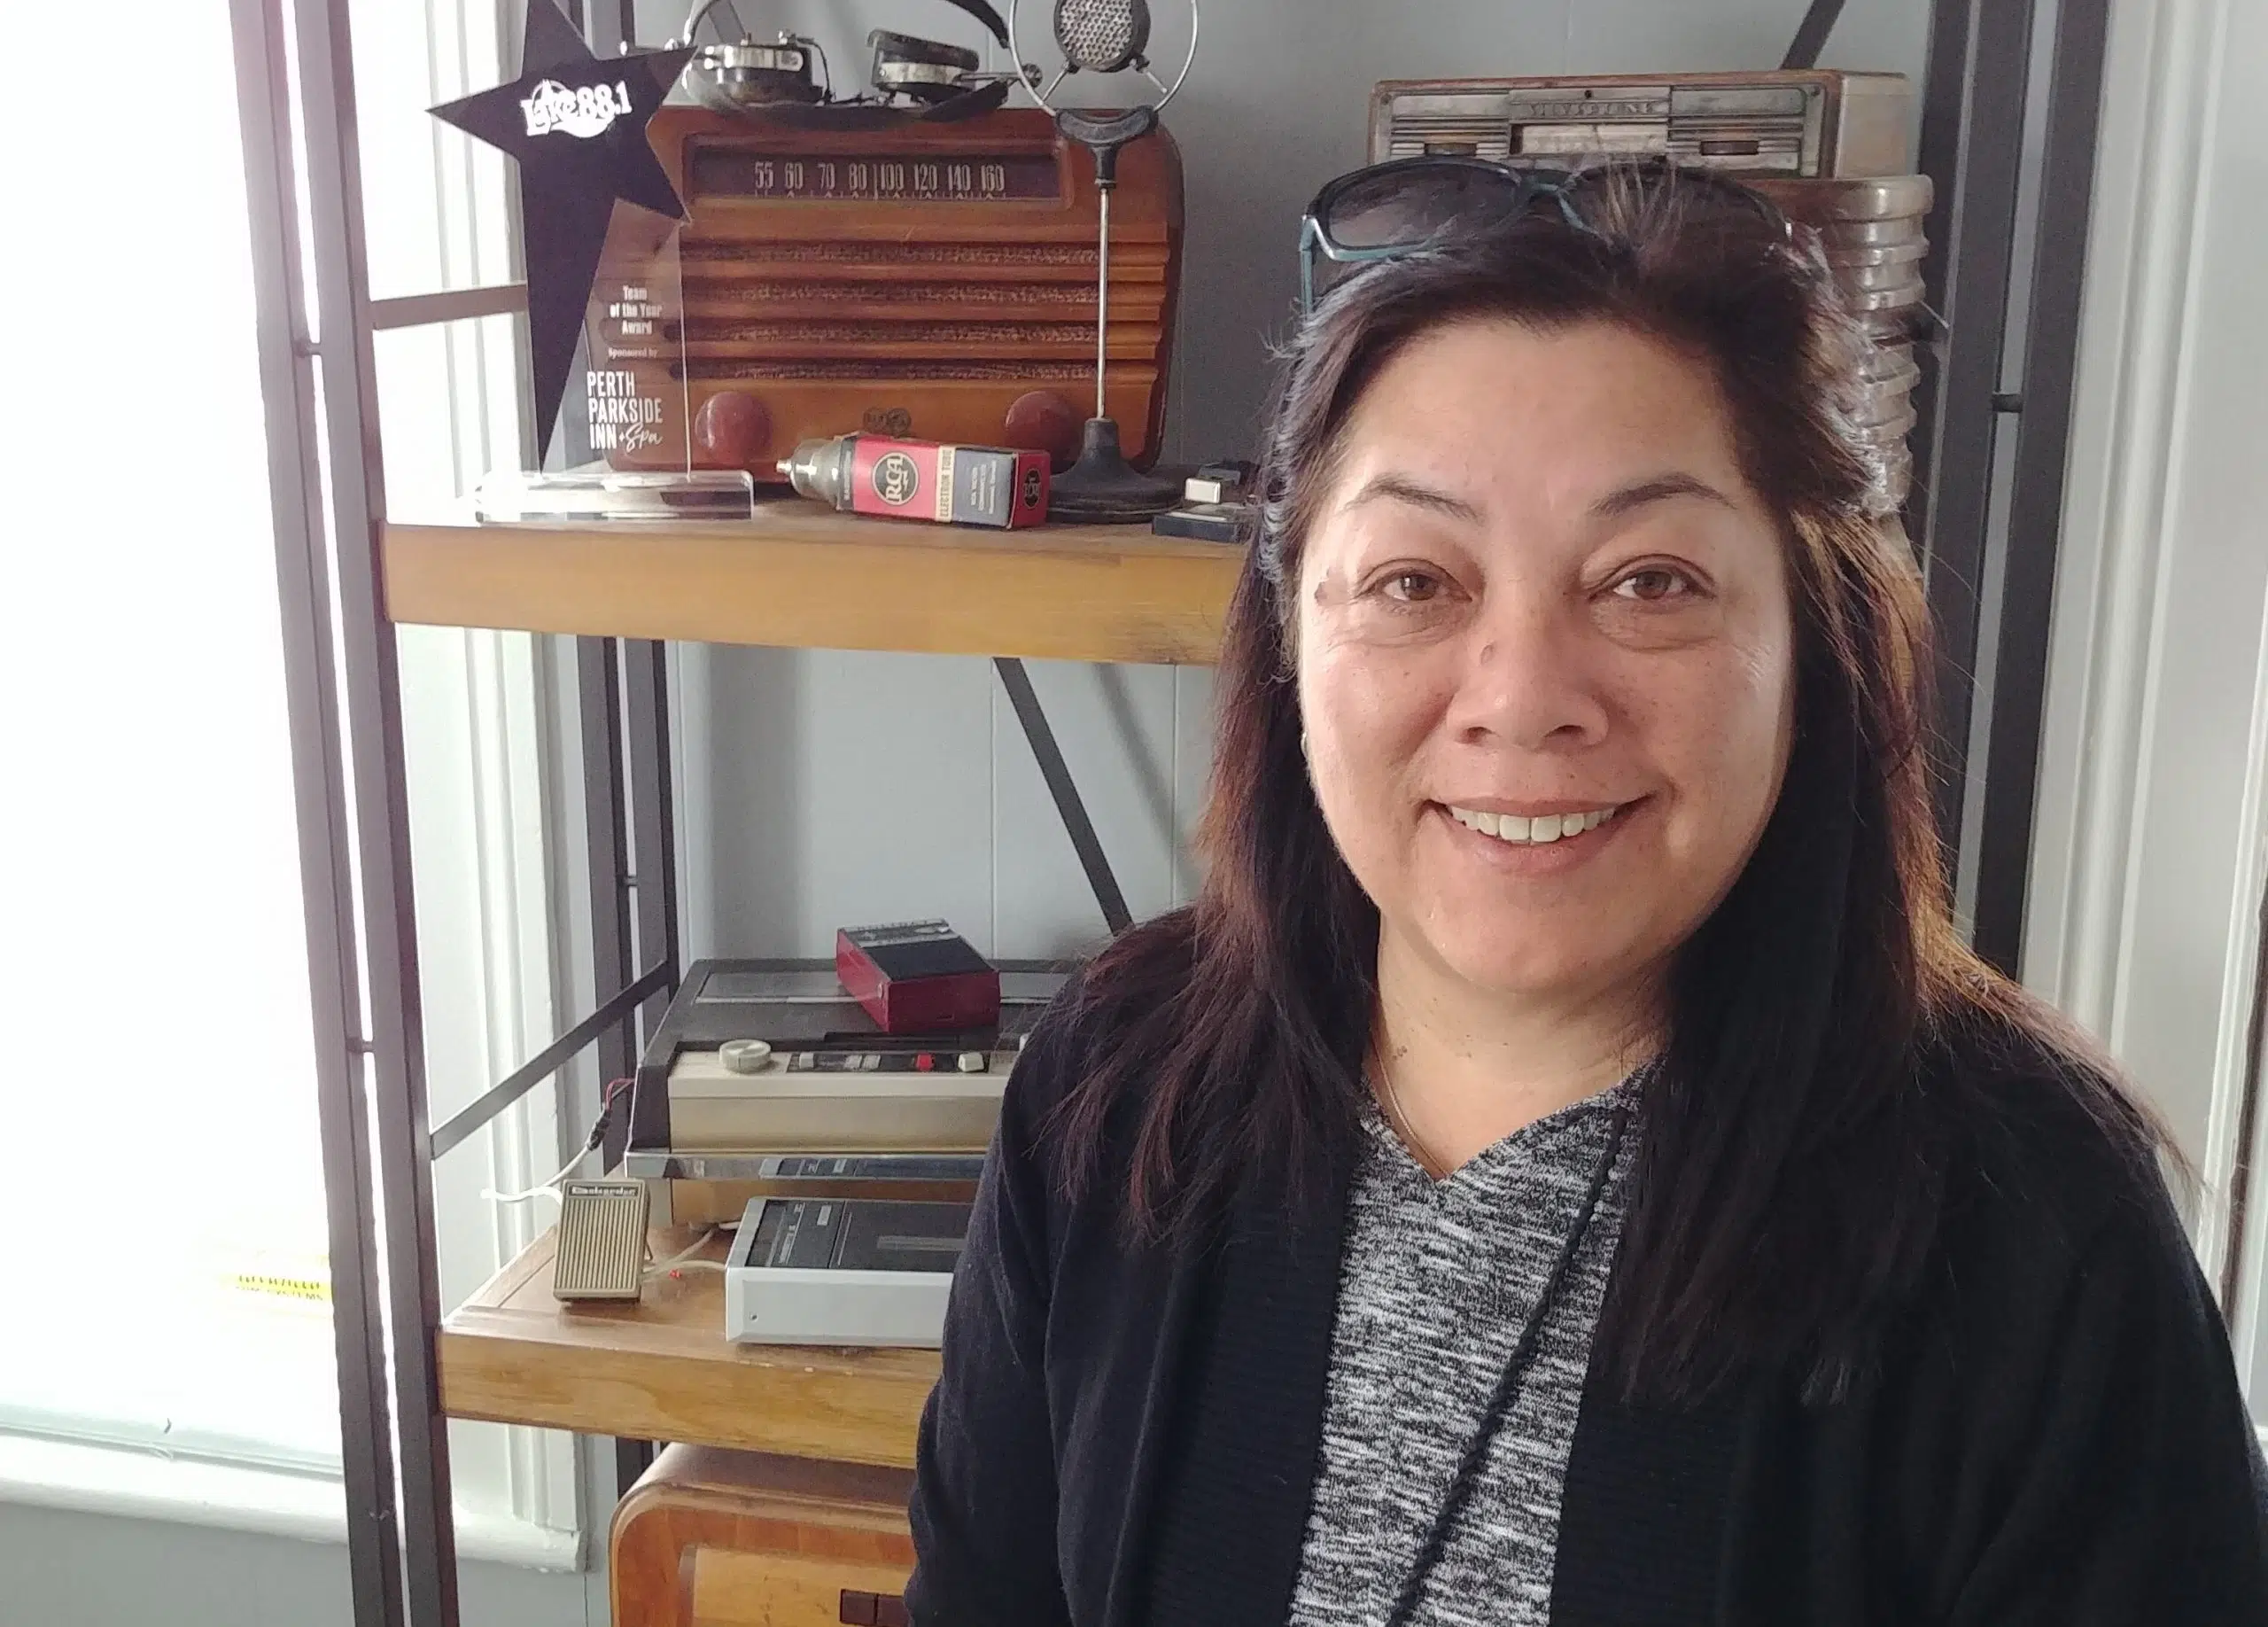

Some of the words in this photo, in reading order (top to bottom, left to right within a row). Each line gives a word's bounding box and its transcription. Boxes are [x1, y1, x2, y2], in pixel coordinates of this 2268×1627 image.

[755, 161, 773, 190] 55
[785, 162, 804, 190] 60
[818, 162, 835, 190] 70
[849, 163, 867, 191] 80
[881, 163, 904, 191] 100
[914, 163, 937, 191] 120
[948, 164, 971, 191] 140
[981, 164, 1005, 191] 160
[623, 284, 647, 300] Team
[610, 302, 620, 317] of
[622, 302, 638, 317] the
[640, 302, 663, 318] Year
[622, 320, 652, 335] Award
[586, 370, 635, 397] PERTH
[588, 398, 663, 424] PARKSIDE
[590, 423, 617, 449] INN
[886, 455, 904, 502] RCA
[940, 474, 950, 518] ELECTRON
